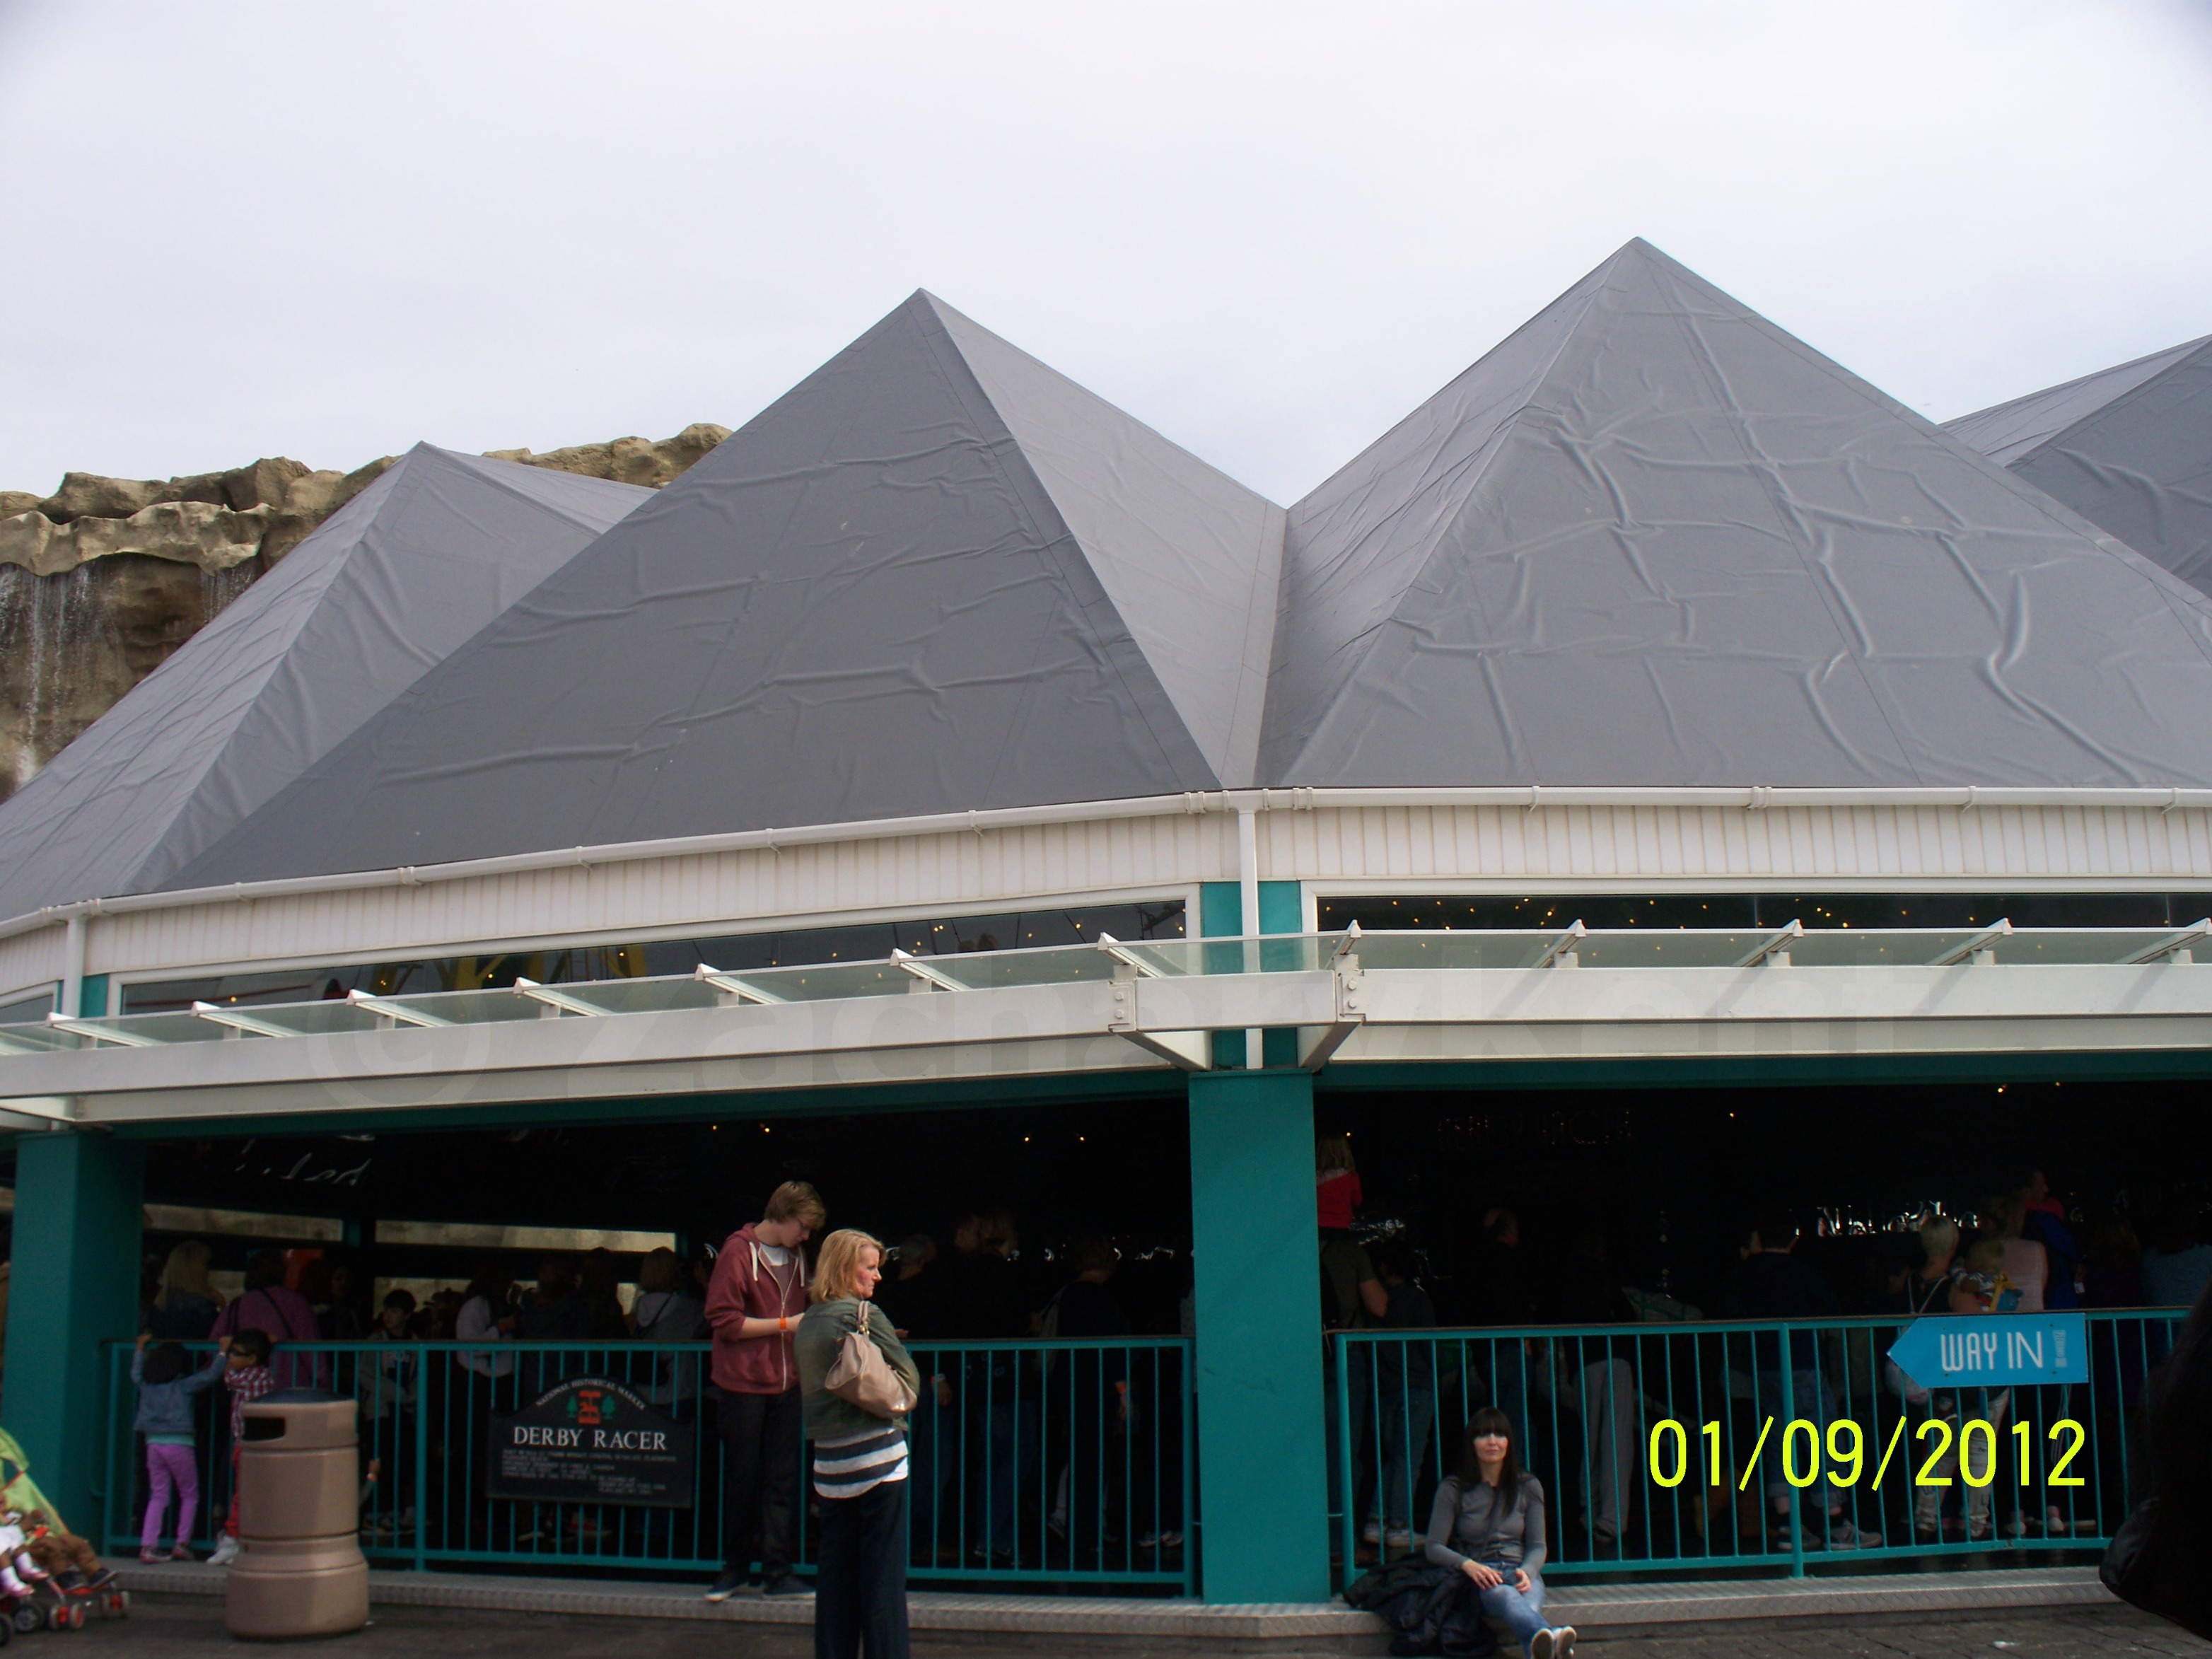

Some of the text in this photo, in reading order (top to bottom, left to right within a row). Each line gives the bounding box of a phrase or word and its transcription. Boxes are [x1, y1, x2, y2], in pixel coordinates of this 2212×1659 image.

[1940, 1332, 1998, 1371] WAY
[2007, 1331, 2044, 1369] IN
[513, 1426, 666, 1450] DERBY RACER
